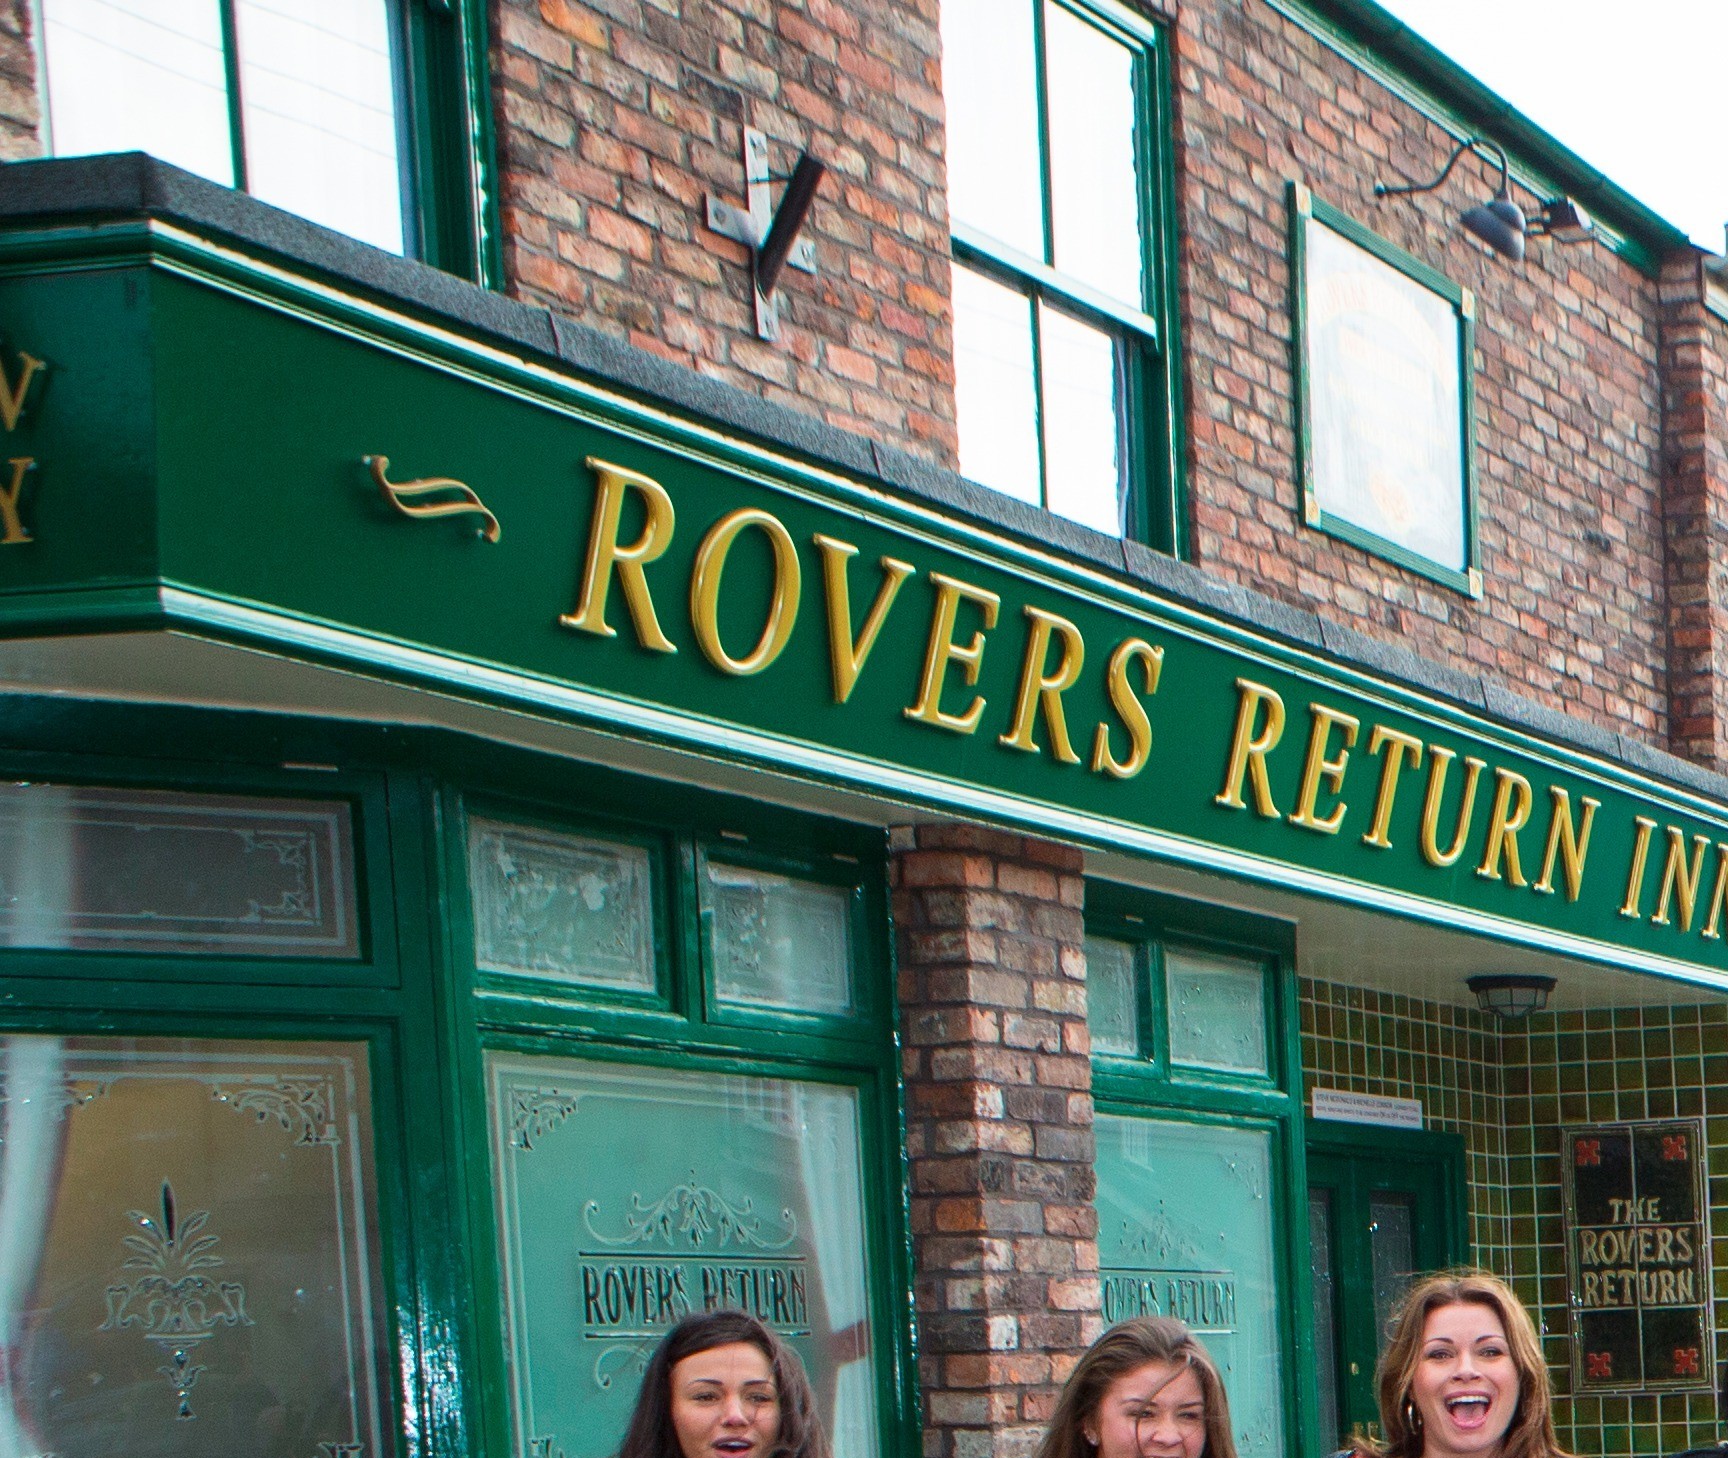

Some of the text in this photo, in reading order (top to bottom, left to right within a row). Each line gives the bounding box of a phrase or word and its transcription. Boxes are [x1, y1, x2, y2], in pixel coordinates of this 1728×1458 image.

[559, 454, 1165, 779] ROVERS
[1214, 677, 1601, 903] RETURN
[1608, 1196, 1662, 1224] THE
[1580, 1227, 1695, 1267] ROVERS
[581, 1263, 809, 1326] ROVERS RETURN
[1101, 1276, 1238, 1325] OVERS RETURN
[1582, 1268, 1697, 1308] RETURN
